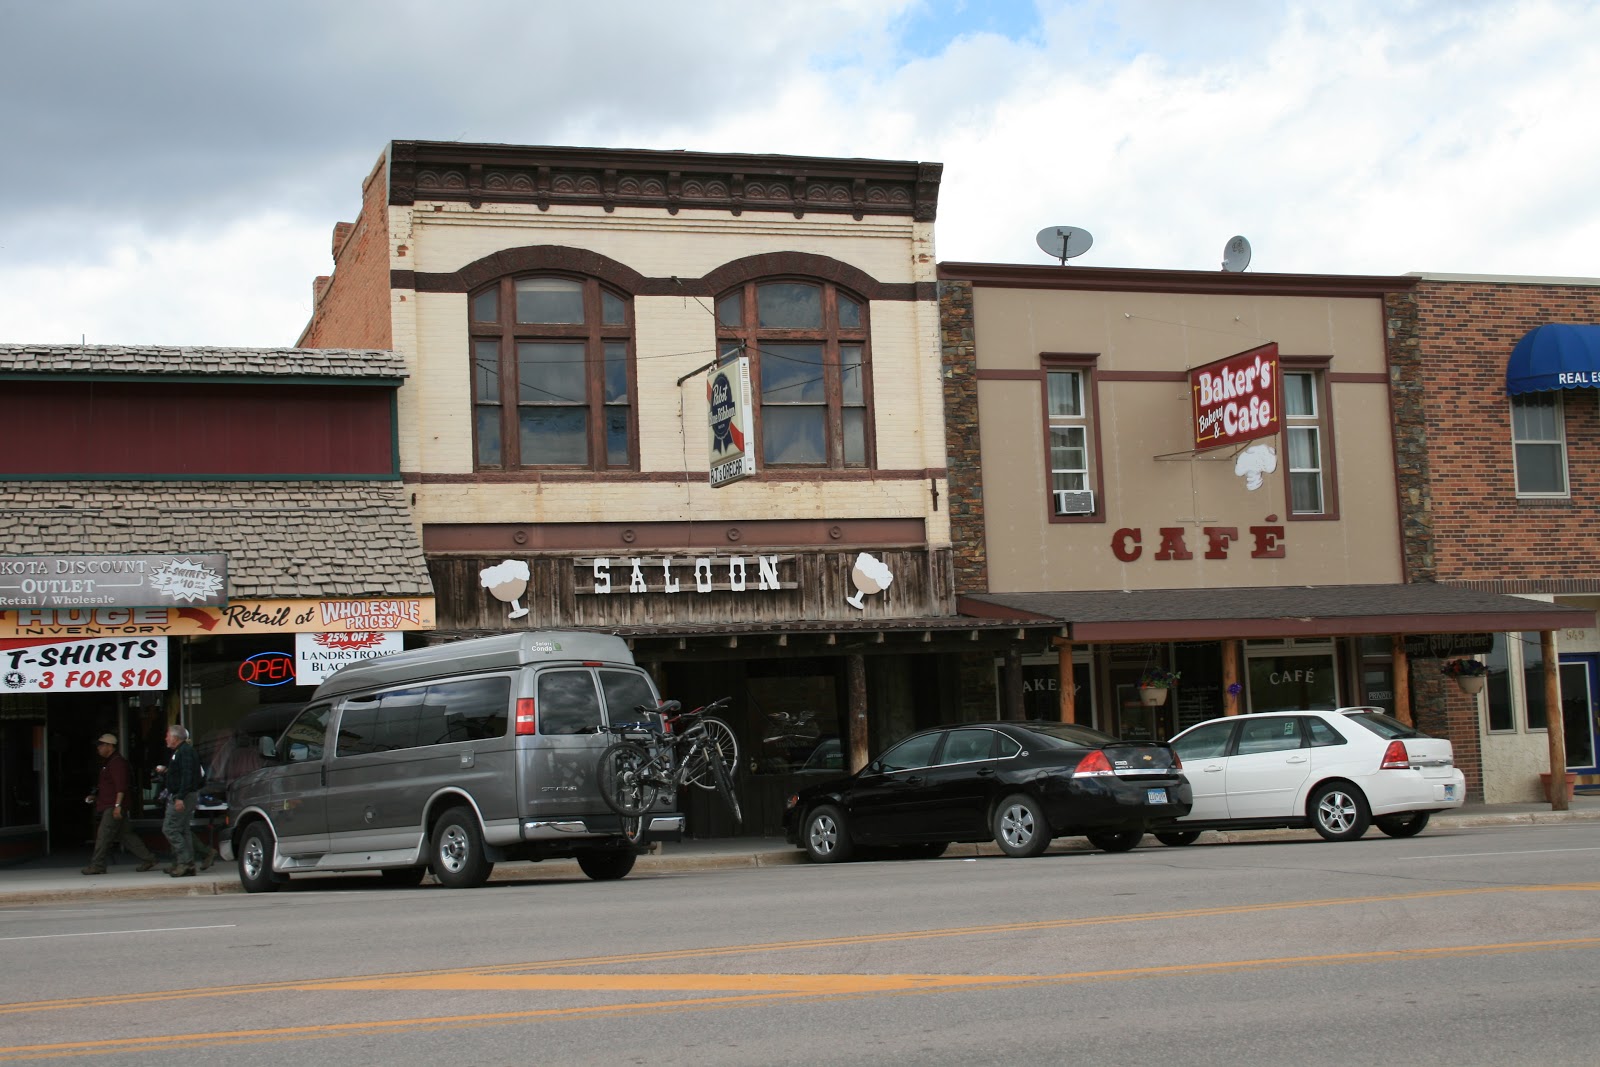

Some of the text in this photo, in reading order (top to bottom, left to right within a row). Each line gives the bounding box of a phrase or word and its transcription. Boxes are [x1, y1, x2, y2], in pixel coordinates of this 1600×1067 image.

[1199, 354, 1272, 407] Baker's
[1558, 372, 1589, 385] REAL
[1198, 405, 1224, 439] Bakery &
[1223, 394, 1272, 437] Cafe
[56, 559, 147, 575] DISCOUNT
[163, 566, 208, 580] T-SHIRTS
[593, 555, 780, 594] SALOON
[21, 578, 96, 594] OUTLET
[0, 596, 37, 606] Retail
[52, 595, 115, 605] Wholesale
[16, 607, 169, 627] HUGE
[222, 600, 420, 629] Retail at WHOLESALE
[345, 612, 403, 631] PRICES!
[15, 625, 172, 635] INVENTORY
[326, 632, 369, 643] 25% OFF
[7, 639, 159, 670] T-SHIRTS
[38, 671, 55, 689] 3
[65, 670, 113, 689] FOR
[119, 668, 163, 689] $10
[238, 658, 296, 682] OPEN
[1269, 667, 1315, 685] CAFÉ
